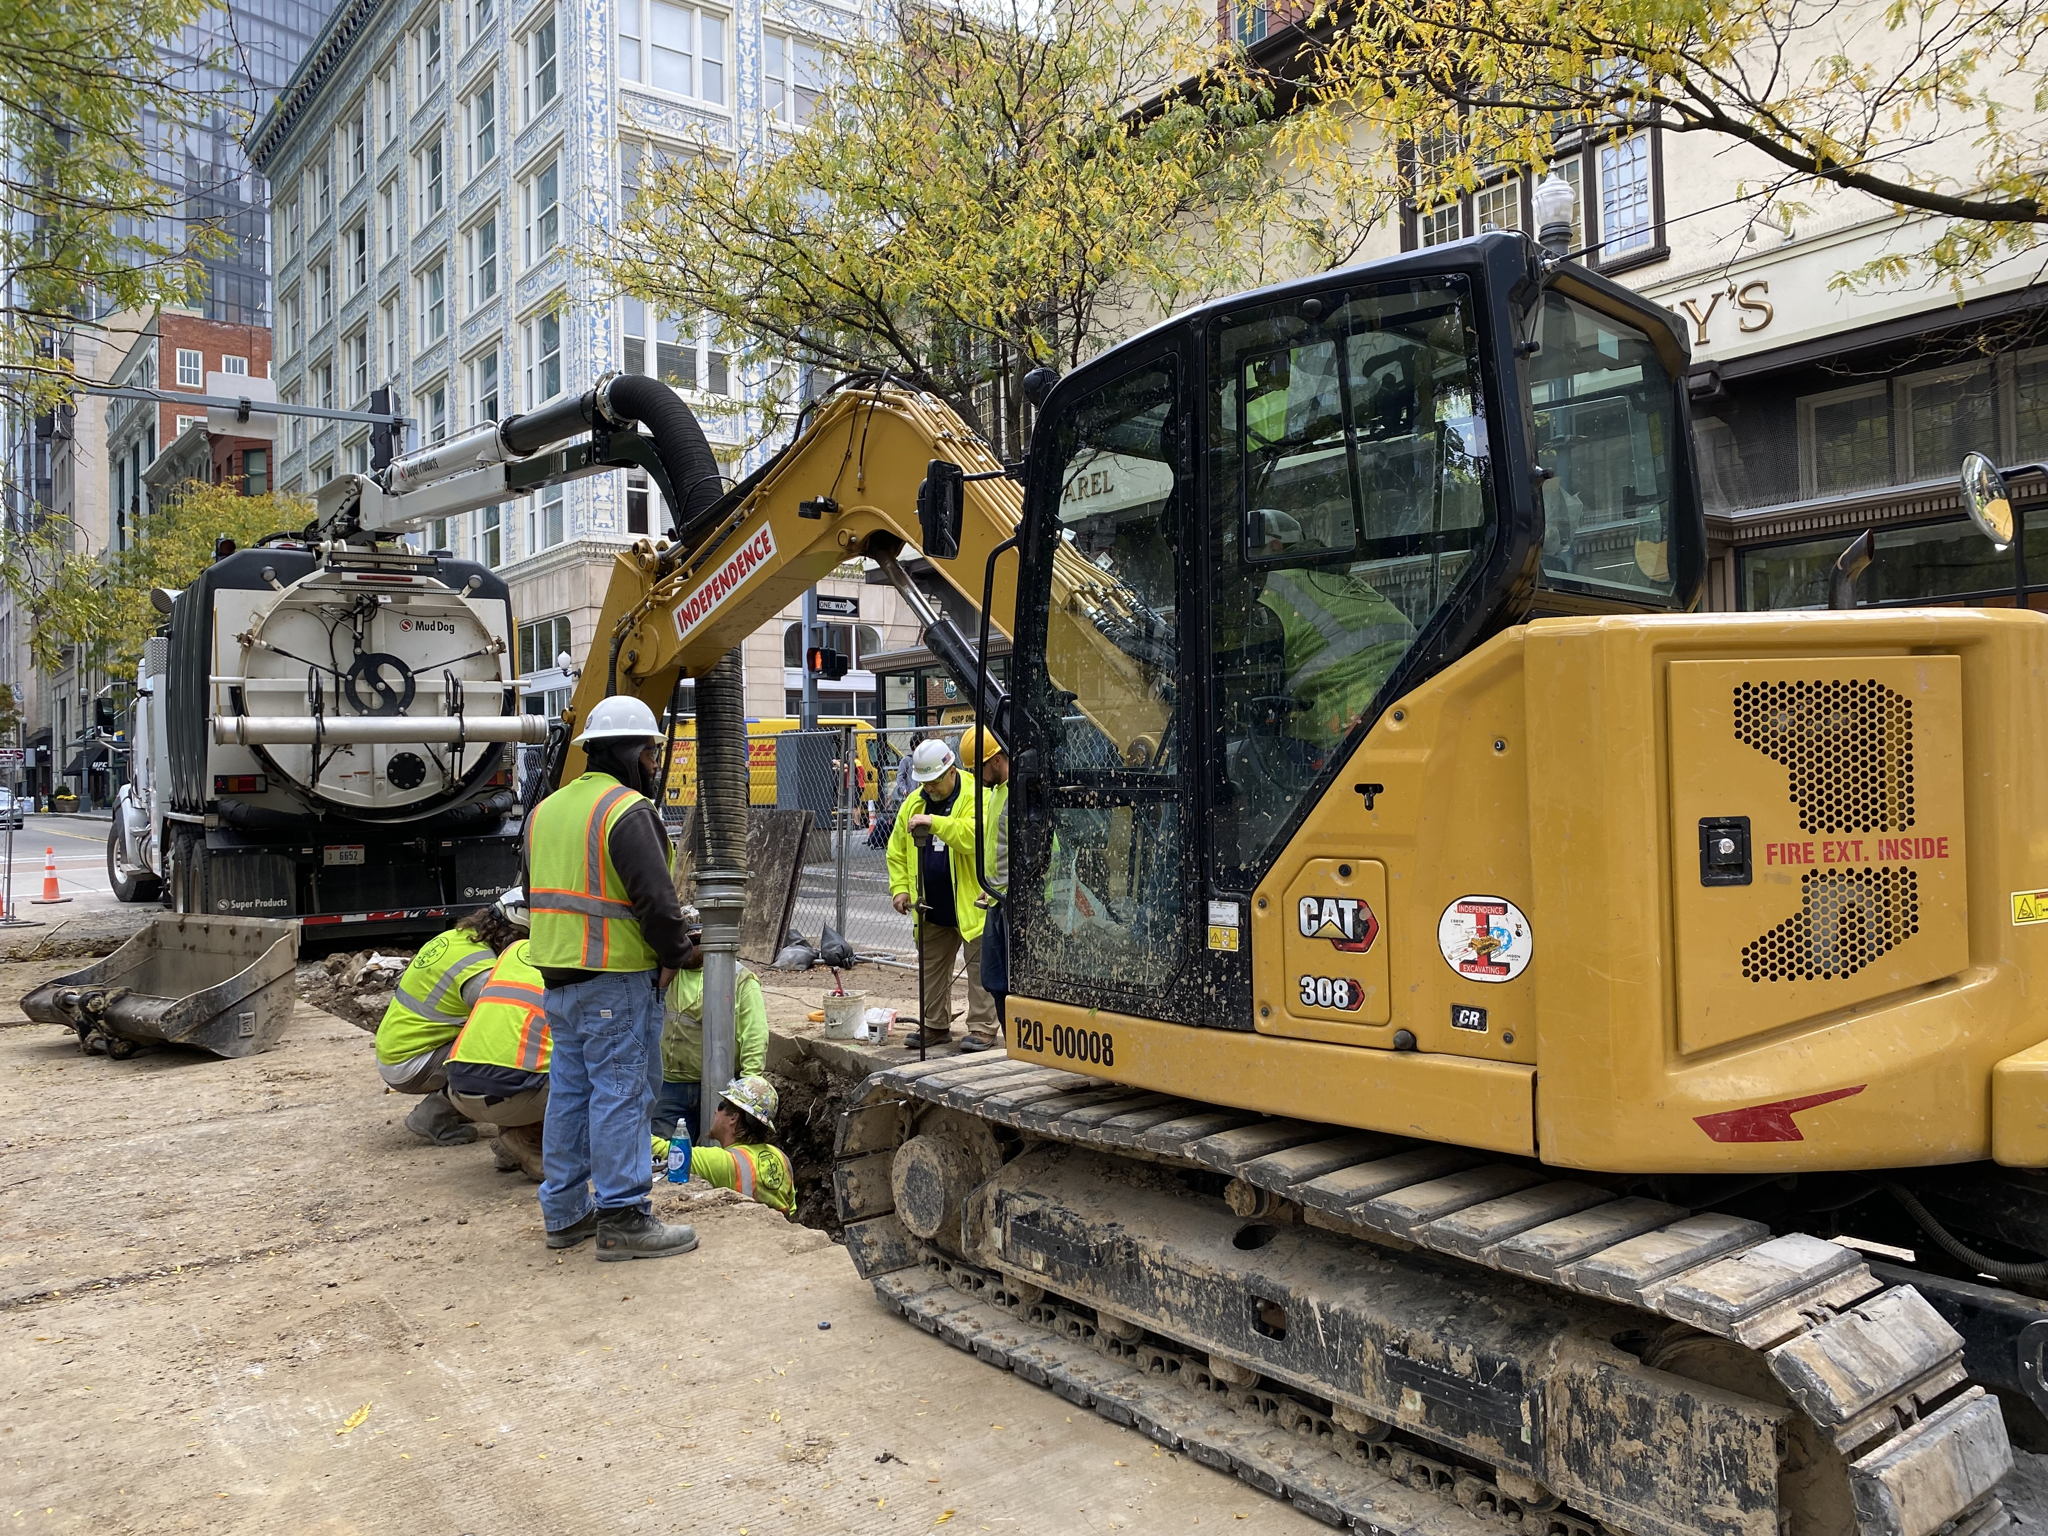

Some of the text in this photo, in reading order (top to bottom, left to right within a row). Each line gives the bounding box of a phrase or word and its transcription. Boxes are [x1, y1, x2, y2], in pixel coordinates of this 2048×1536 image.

[1668, 281, 1774, 346] Y'S
[677, 529, 772, 633] INDEPENDENCE
[820, 601, 831, 609] ONE
[415, 620, 455, 635] Mud Dog
[951, 715, 964, 724] SHOP
[1766, 837, 1950, 865] FIRE EXT. INSIDE
[475, 888, 494, 897] Super
[231, 898, 288, 911] Super Products
[1458, 904, 1504, 915] INDEPENDENCE
[1299, 897, 1358, 940] CAT
[1462, 964, 1500, 975] EXCAVATING
[1300, 976, 1350, 1008] 308
[1459, 1010, 1480, 1026] CR
[1014, 1016, 1114, 1067] 120-00008
